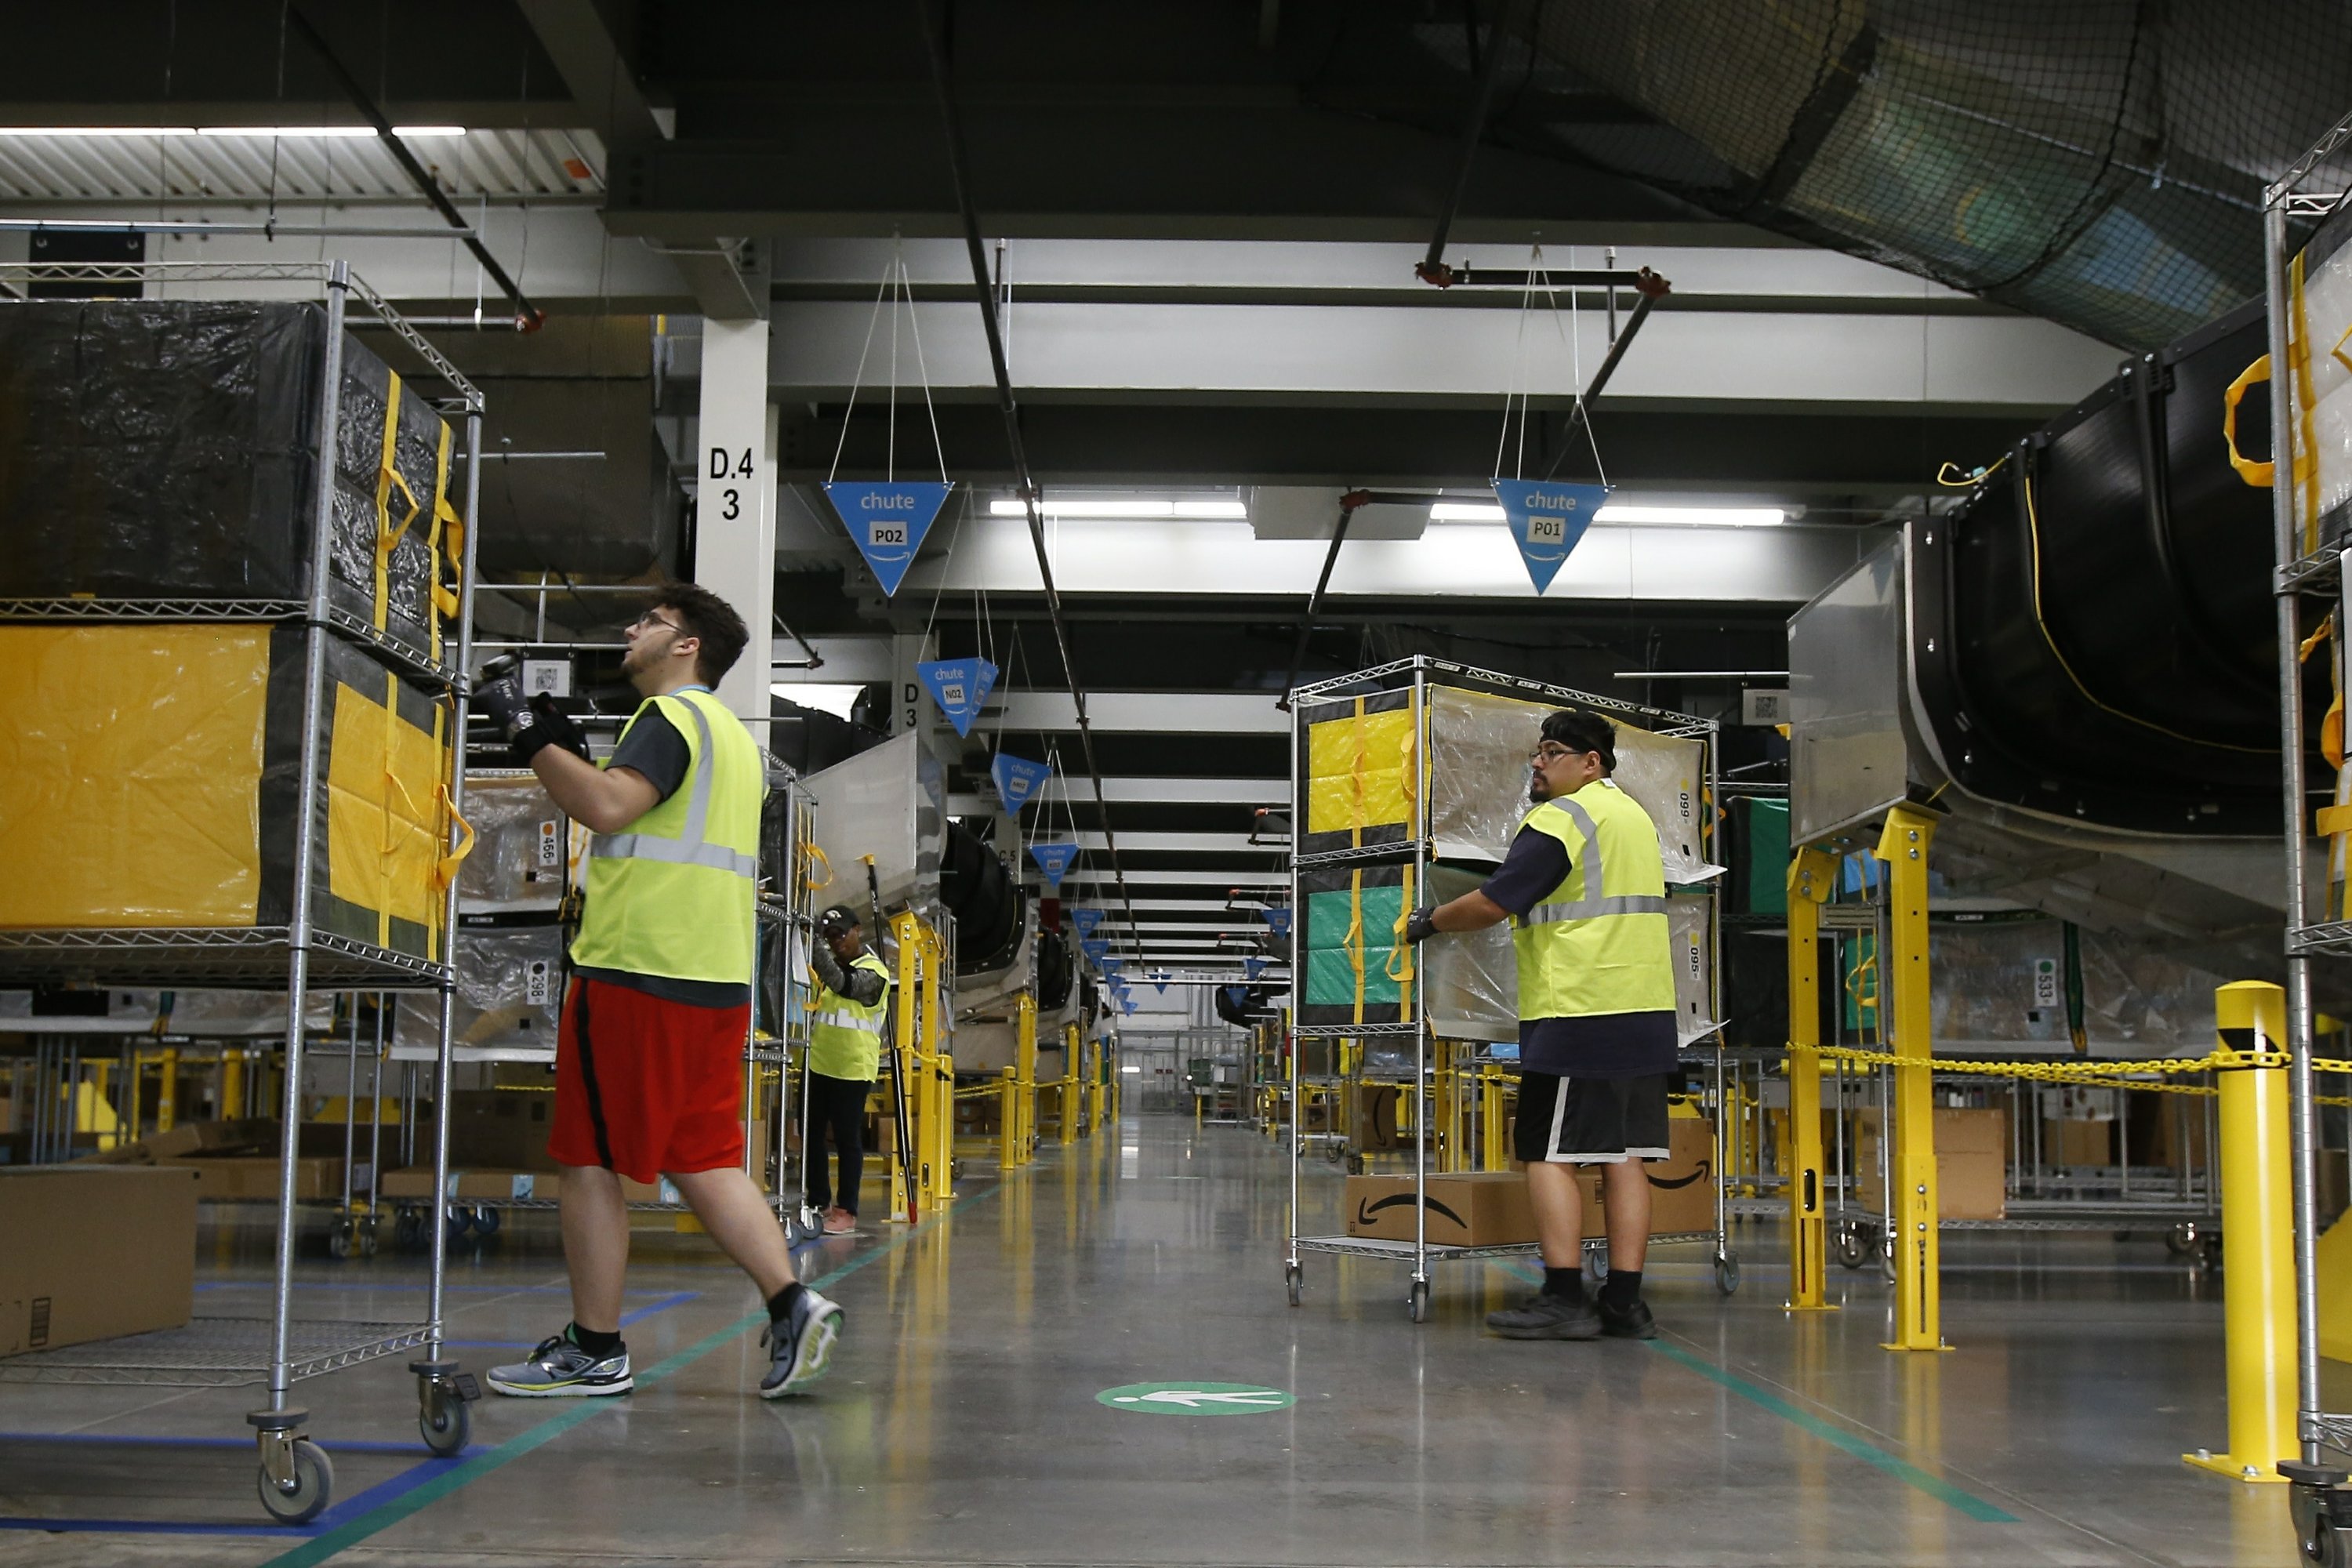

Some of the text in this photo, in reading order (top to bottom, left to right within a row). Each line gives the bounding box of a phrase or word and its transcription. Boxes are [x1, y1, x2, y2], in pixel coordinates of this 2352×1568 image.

[710, 448, 753, 479] D.4
[722, 488, 739, 521] 3
[861, 492, 915, 510] chute
[1526, 491, 1577, 510] chute
[875, 529, 903, 543] P02
[1534, 522, 1561, 536] P01
[935, 668, 964, 681] chute
[905, 684, 918, 703] D
[945, 689, 963, 699] N02
[906, 709, 916, 727] 3
[1011, 764, 1036, 777] chute
[1680, 792, 1690, 818] 099
[543, 837, 554, 859] 466
[1690, 947, 1700, 973] 095
[532, 975, 544, 996] 298
[2038, 975, 2053, 998] 533
